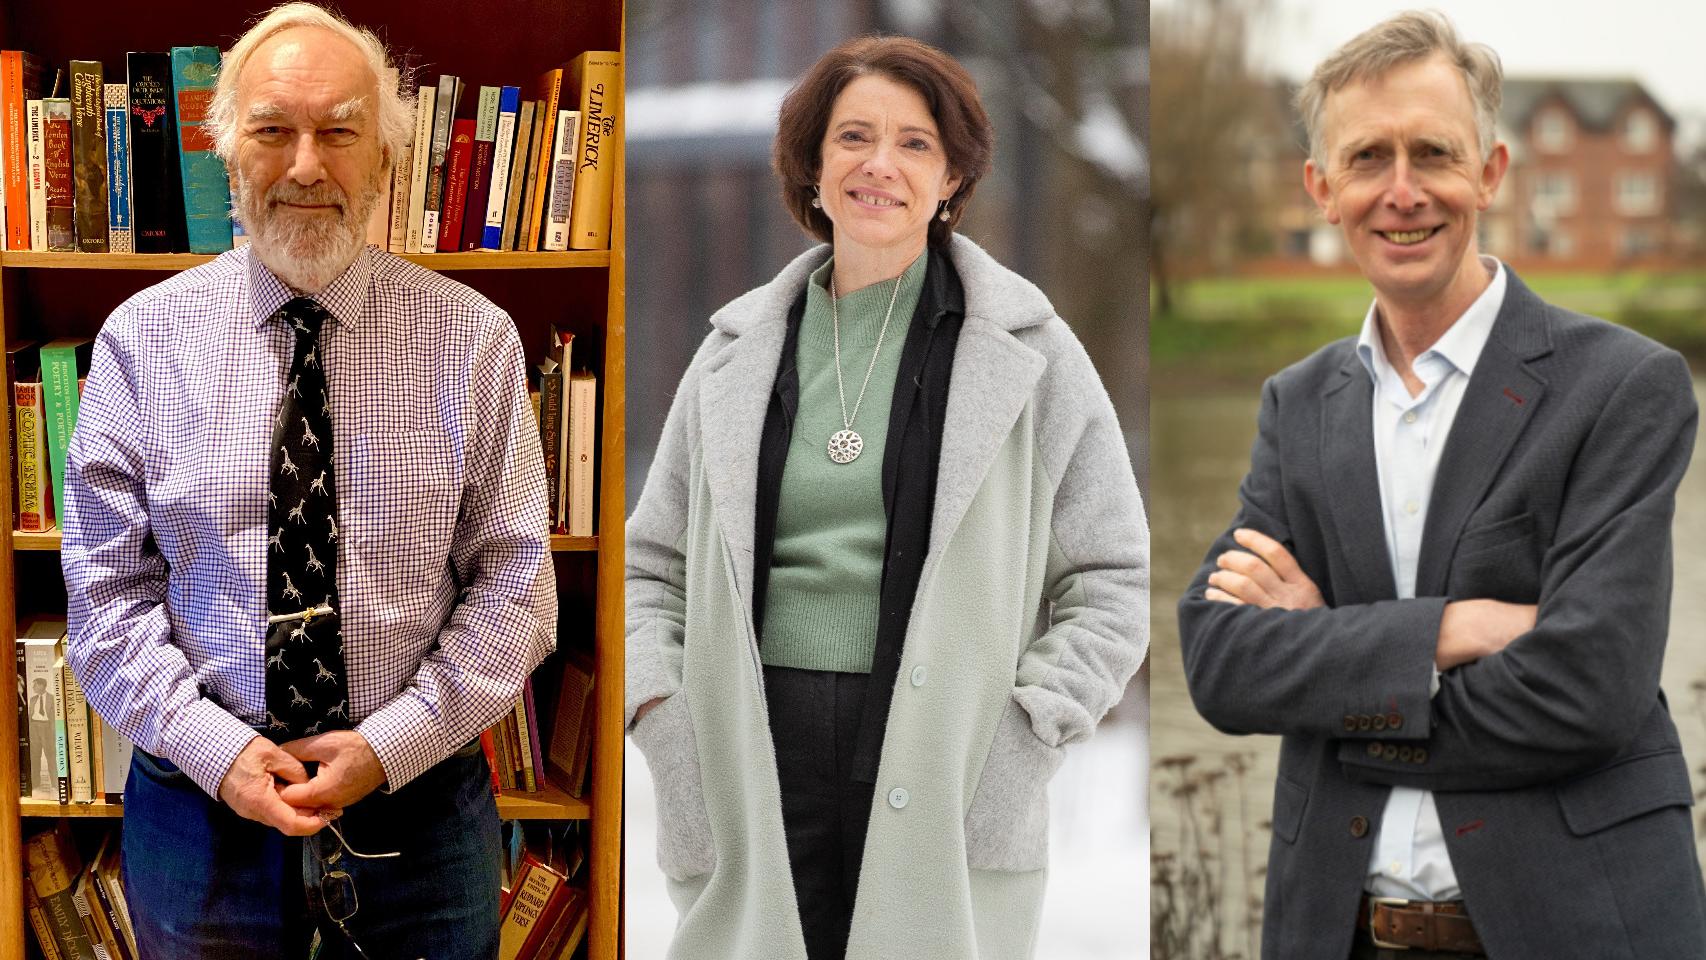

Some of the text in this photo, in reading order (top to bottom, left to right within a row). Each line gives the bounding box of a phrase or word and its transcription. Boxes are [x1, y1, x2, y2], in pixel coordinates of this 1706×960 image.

[72, 72, 86, 127] Century Verse
[82, 73, 96, 117] Eighteenth
[31, 105, 39, 117] THE
[32, 117, 40, 142] LIMERICK
[45, 129, 68, 140] London
[579, 83, 605, 174] LIMERICK
[602, 115, 617, 137] The
[46, 159, 71, 169] English
[450, 150, 460, 173] Treasury
[554, 165, 566, 213] CURMUDGEON
[427, 212, 435, 239] POEMS
[443, 220, 451, 238] Poems
[51, 361, 61, 397] POETRY
[56, 412, 67, 450] POETICS
[548, 391, 556, 411] Auld
[21, 408, 36, 460] COMIC
[546, 431, 556, 451] Syne
[67, 689, 76, 715] POEMS
[519, 889, 545, 908] RUDYARD
[50, 895, 69, 927] EMILY
[512, 912, 530, 927] VERSE
